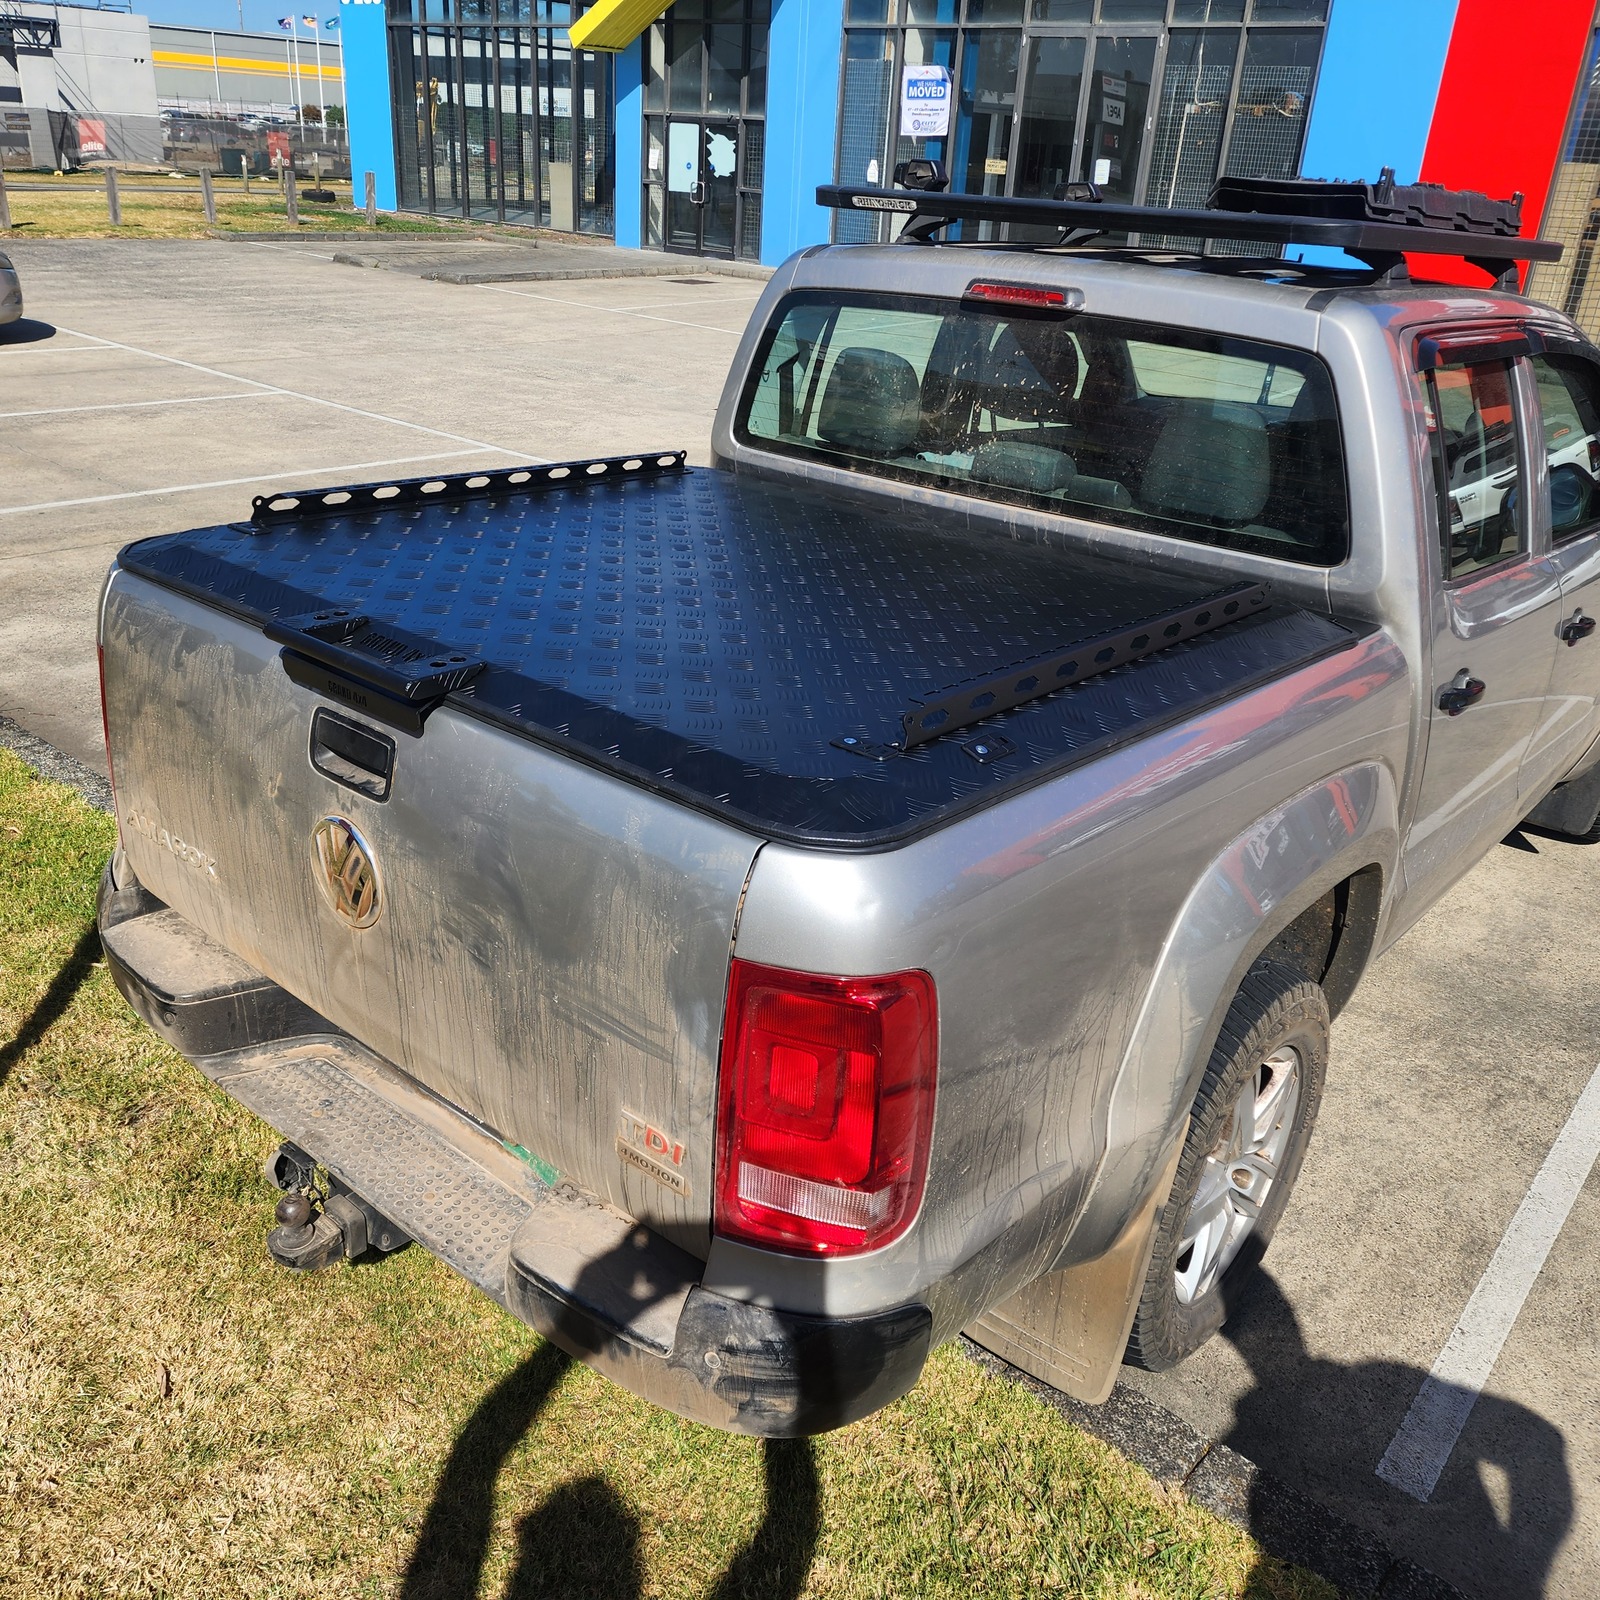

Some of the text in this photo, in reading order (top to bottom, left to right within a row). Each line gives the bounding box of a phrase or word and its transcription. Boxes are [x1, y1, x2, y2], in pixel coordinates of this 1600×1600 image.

[908, 86, 944, 98] MOVED
[81, 141, 104, 150] elite
[271, 157, 290, 166] ete
[618, 1107, 686, 1168] TDI
